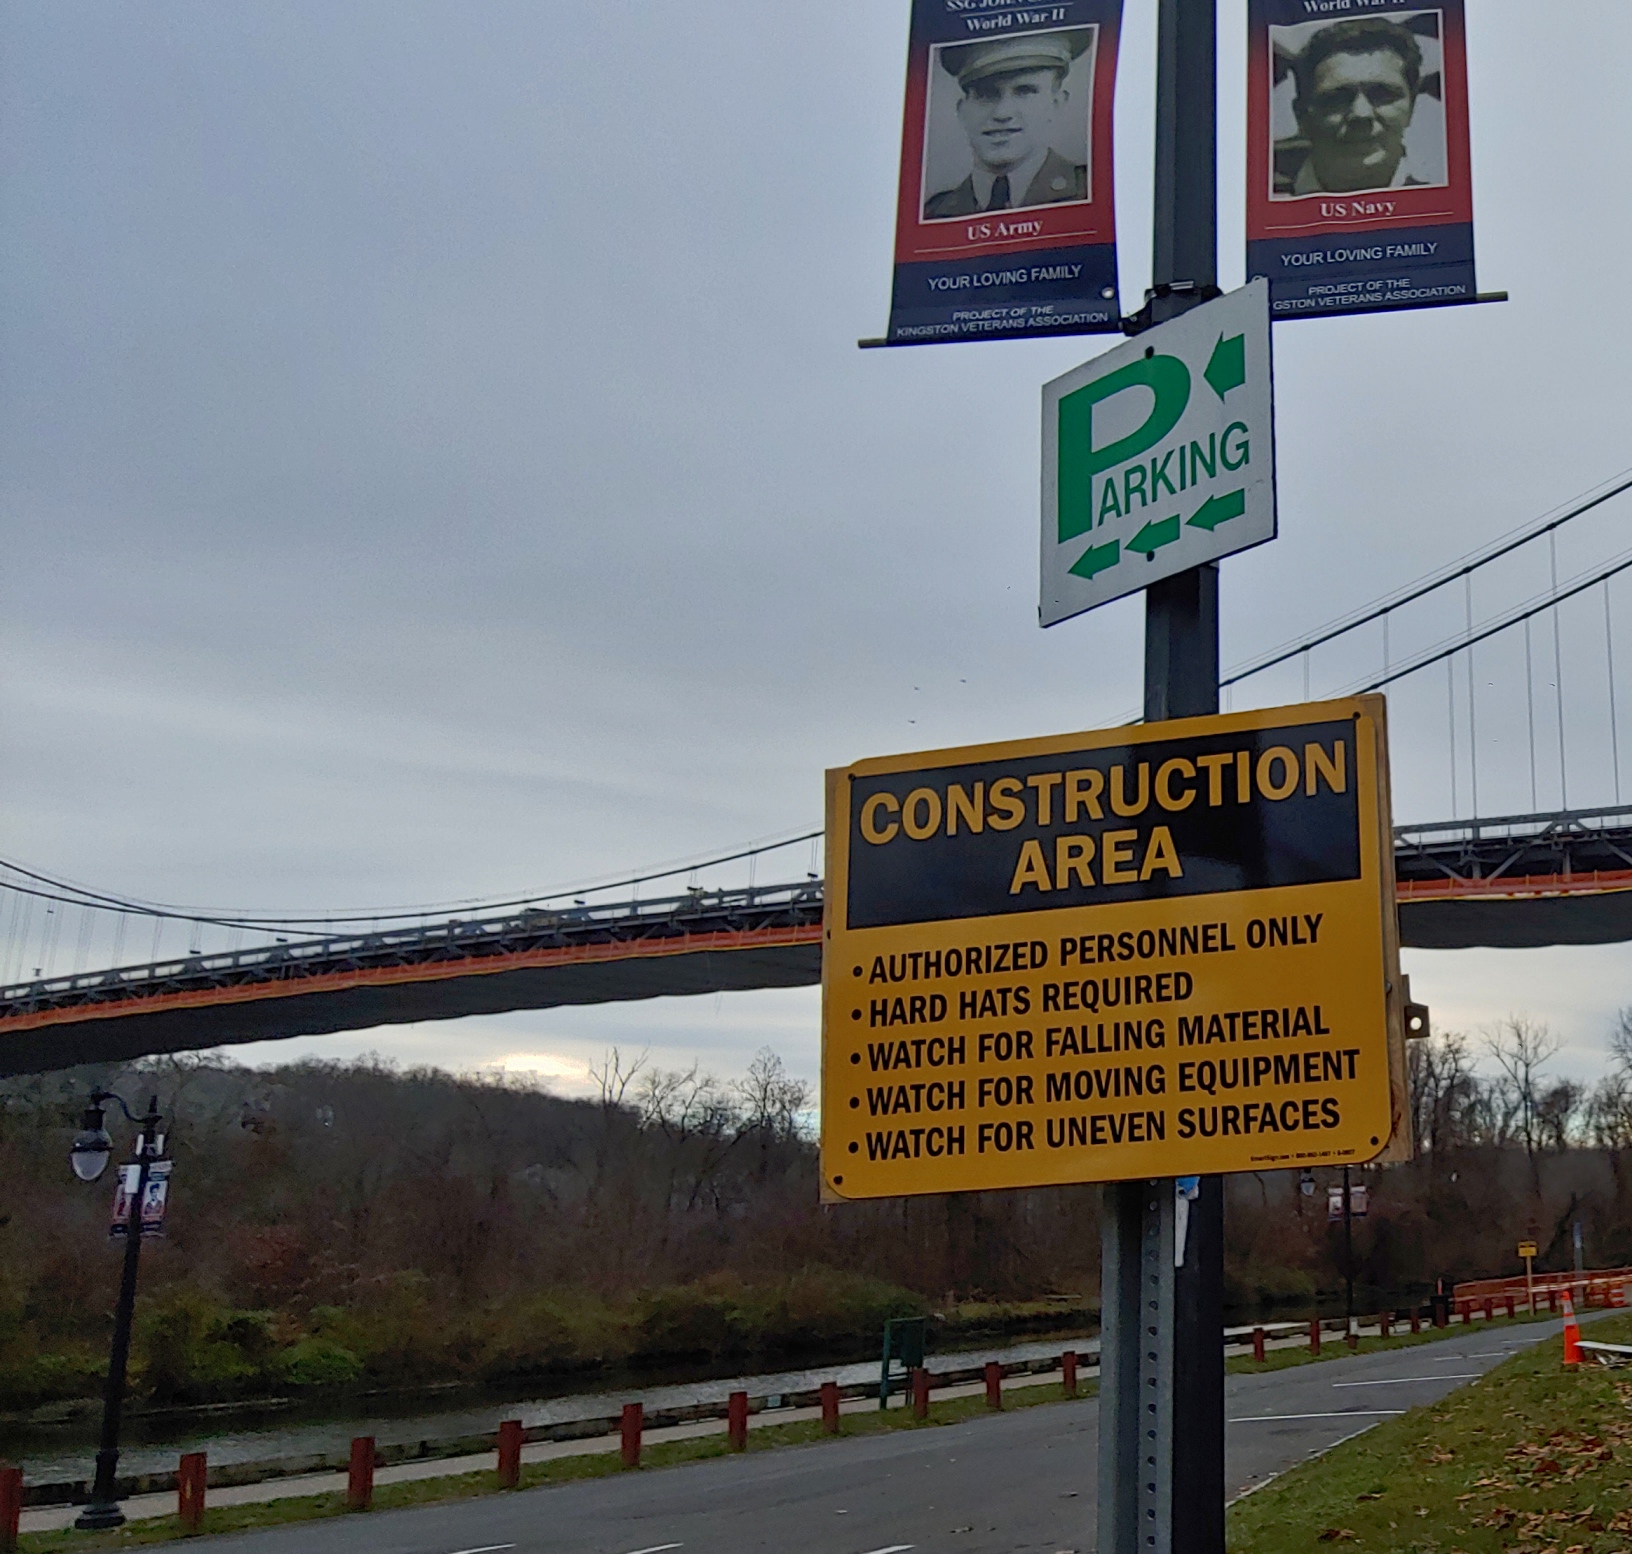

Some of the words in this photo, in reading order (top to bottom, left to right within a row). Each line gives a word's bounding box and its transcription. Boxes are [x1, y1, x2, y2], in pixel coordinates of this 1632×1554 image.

[1304, 0, 1350, 13] World
[966, 14, 1012, 31] World
[1017, 11, 1049, 24] War
[1052, 8, 1065, 20] II
[1320, 203, 1347, 217] US
[1351, 201, 1396, 216] Navy
[967, 223, 991, 240] US
[994, 220, 1043, 237] Army
[1281, 252, 1323, 266] YOUR
[1326, 247, 1382, 262] LOVING
[1386, 242, 1438, 257] FAMILY
[928, 274, 970, 291] YOUR
[973, 269, 1027, 287] LOVING
[1031, 265, 1082, 281] FAMILY
[1308, 282, 1364, 295] PROJECT
[1367, 280, 1384, 290] OF
[1386, 279, 1411, 289] THE
[1273, 298, 1315, 310] GSTON
[1318, 293, 1382, 307] VETERANS
[1385, 285, 1466, 300] ASSOCIATION
[897, 322, 958, 337] KINGSTON
[961, 318, 1025, 333] VETERANS
[1027, 312, 1108, 327] ASSOCIATION
[952, 307, 1007, 321] PROJECT
[1010, 306, 1028, 317] OF
[1030, 305, 1054, 315] THE
[1058, 354, 1250, 544] PARKING
[860, 739, 1346, 845] CONSTRUCTION
[1009, 826, 1184, 894] AREA
[869, 941, 1048, 984] AUTHORIZED
[1060, 922, 1235, 966] PERSONNEL
[1246, 913, 1323, 949] ONLY
[870, 994, 947, 1027] HARD
[959, 986, 1031, 1020] HATS
[1042, 972, 1193, 1013] REQUIRED
[867, 1035, 965, 1072] WATCH
[978, 1030, 1034, 1063] FOR
[1046, 1019, 1165, 1057] FALLING
[1178, 1005, 1330, 1046] MATERIAL
[866, 1080, 965, 1116] WATCH
[978, 1075, 1034, 1108] FOR
[1046, 1065, 1166, 1103] MOVING
[1178, 1049, 1360, 1096] EQUIPMENT
[866, 1125, 965, 1161] WATCH
[978, 1121, 1035, 1153] FOR
[1046, 1110, 1165, 1148] UNEVEN
[1177, 1097, 1340, 1139] SURFACES
